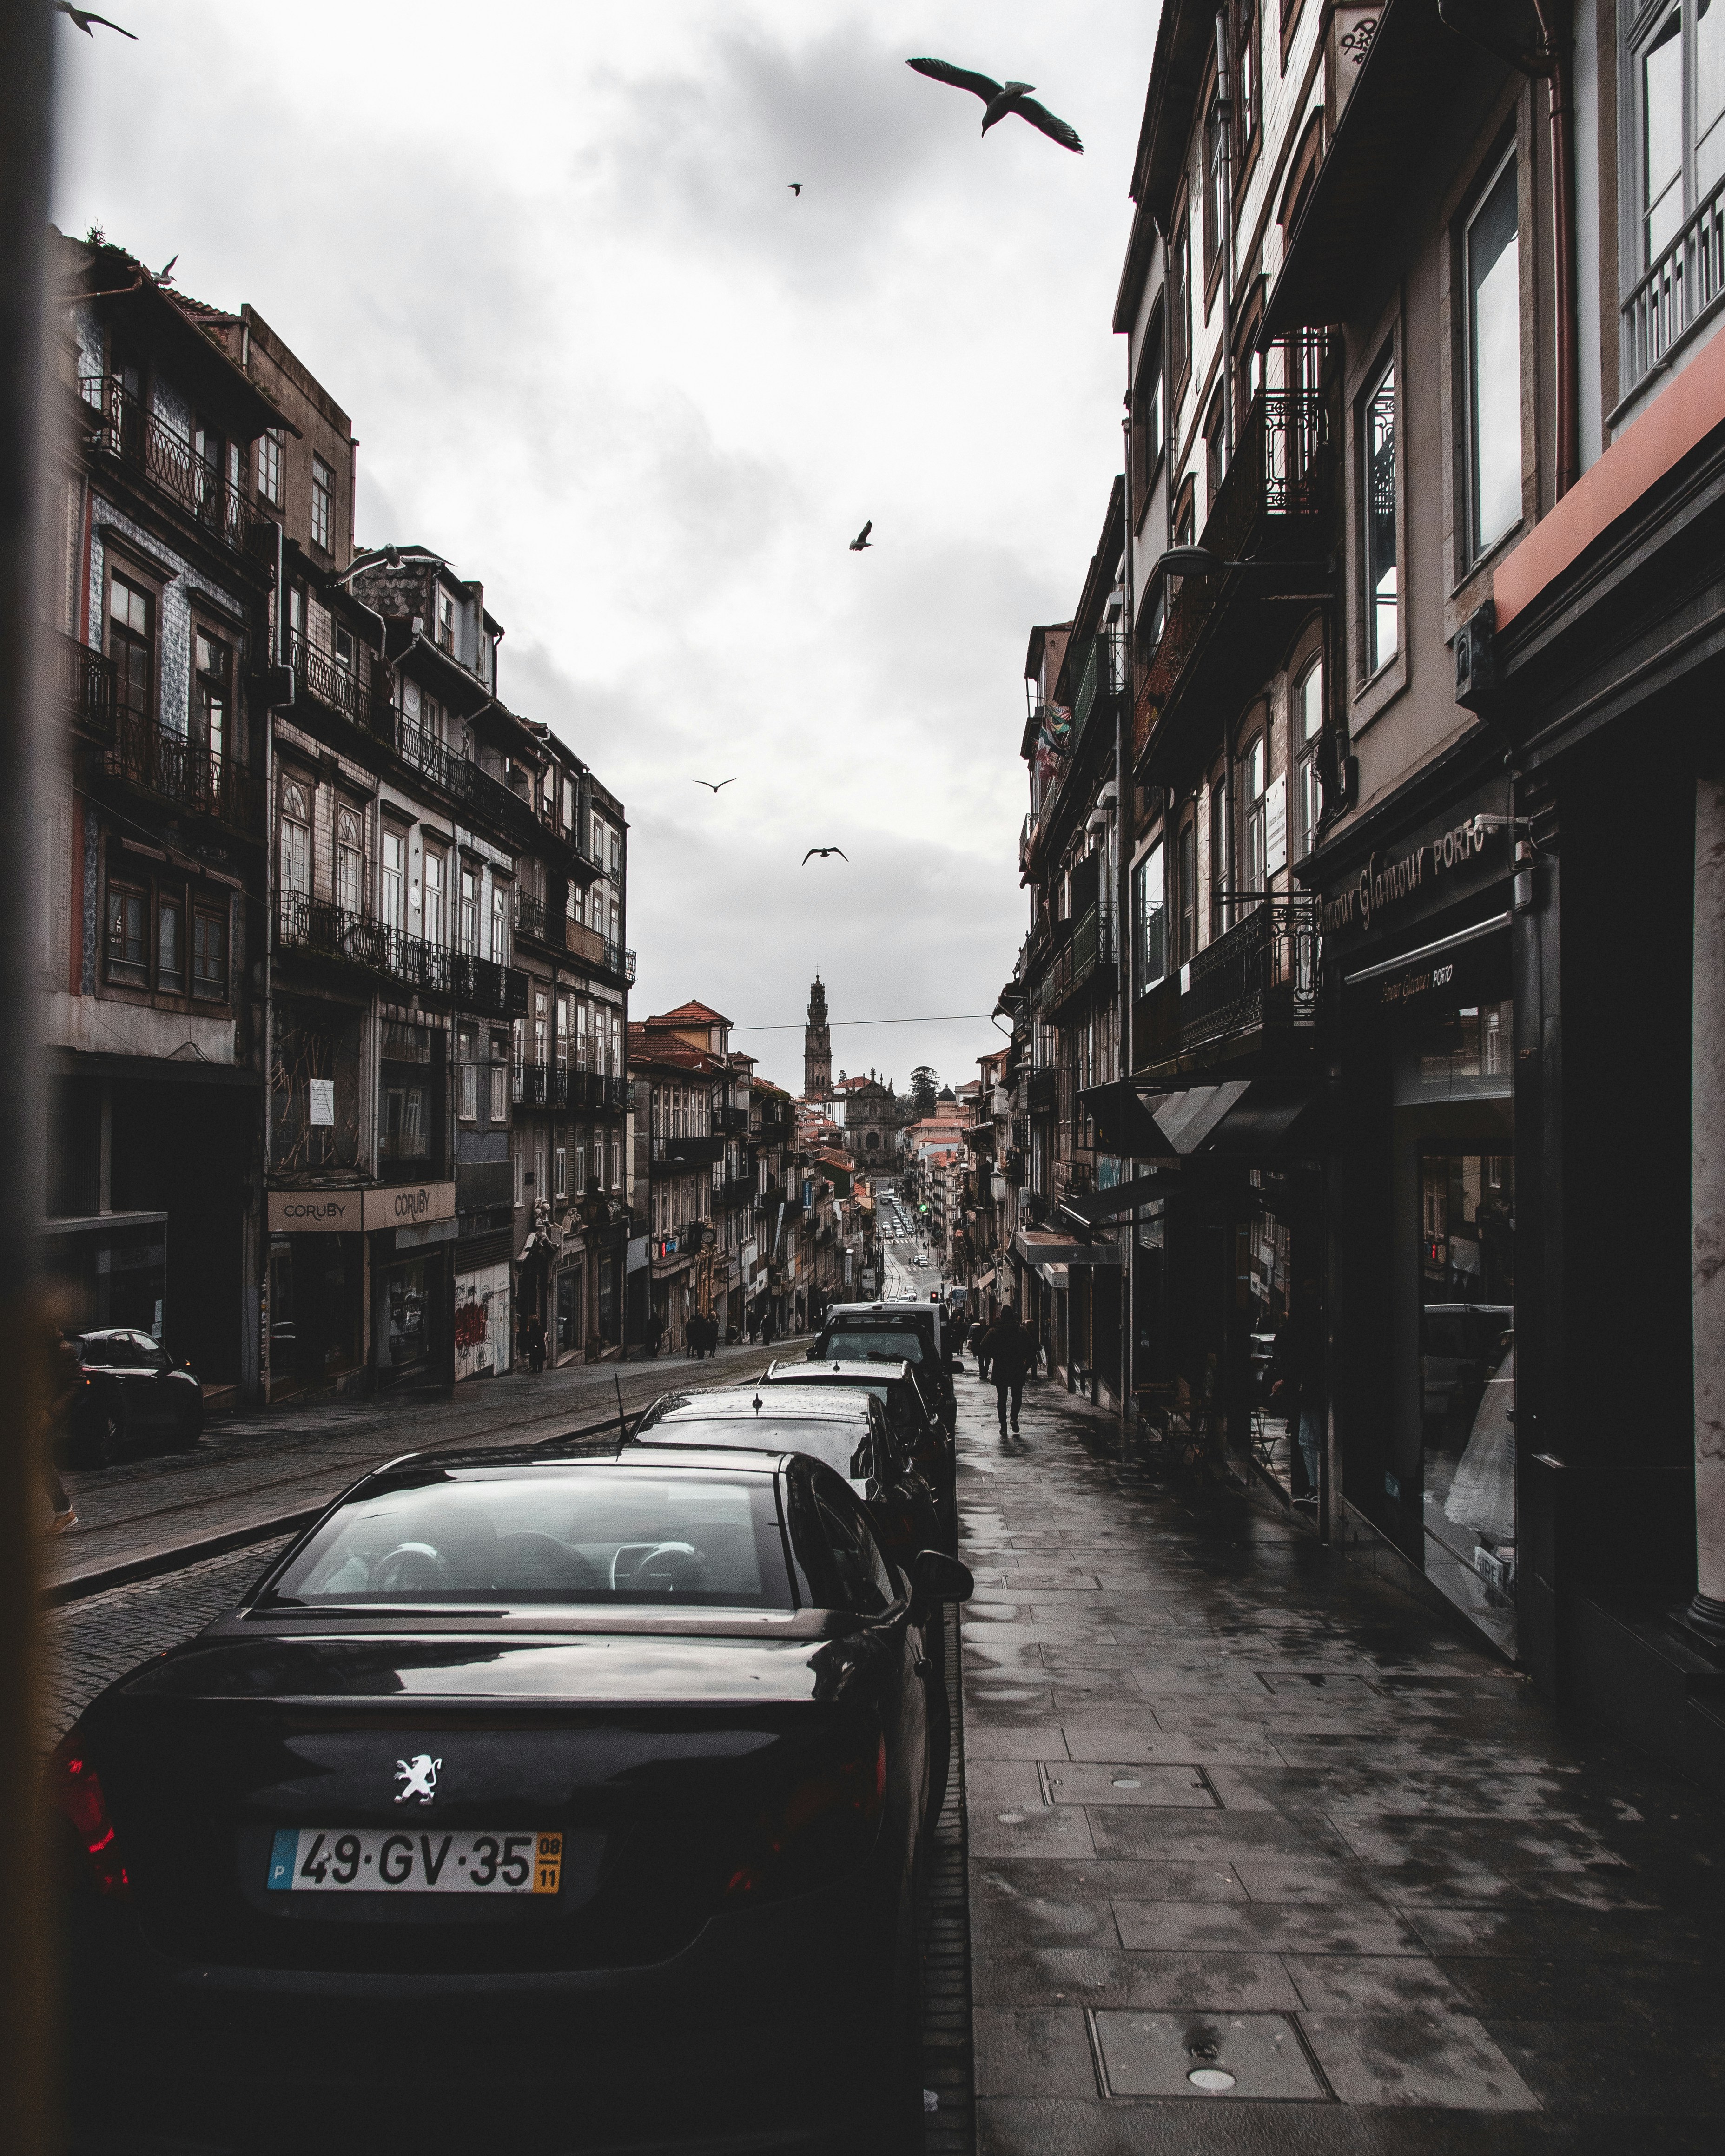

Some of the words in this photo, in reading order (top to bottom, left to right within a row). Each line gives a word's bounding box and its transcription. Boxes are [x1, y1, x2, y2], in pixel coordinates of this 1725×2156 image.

[1359, 847, 1426, 930] Glamour
[1432, 964, 1454, 988] PORTO
[284, 1203, 346, 1221] CORUBY
[395, 1189, 430, 1221] CORUBY
[273, 1866, 285, 1880] P
[539, 1838, 560, 1856] 08
[539, 1870, 556, 1887] 11
